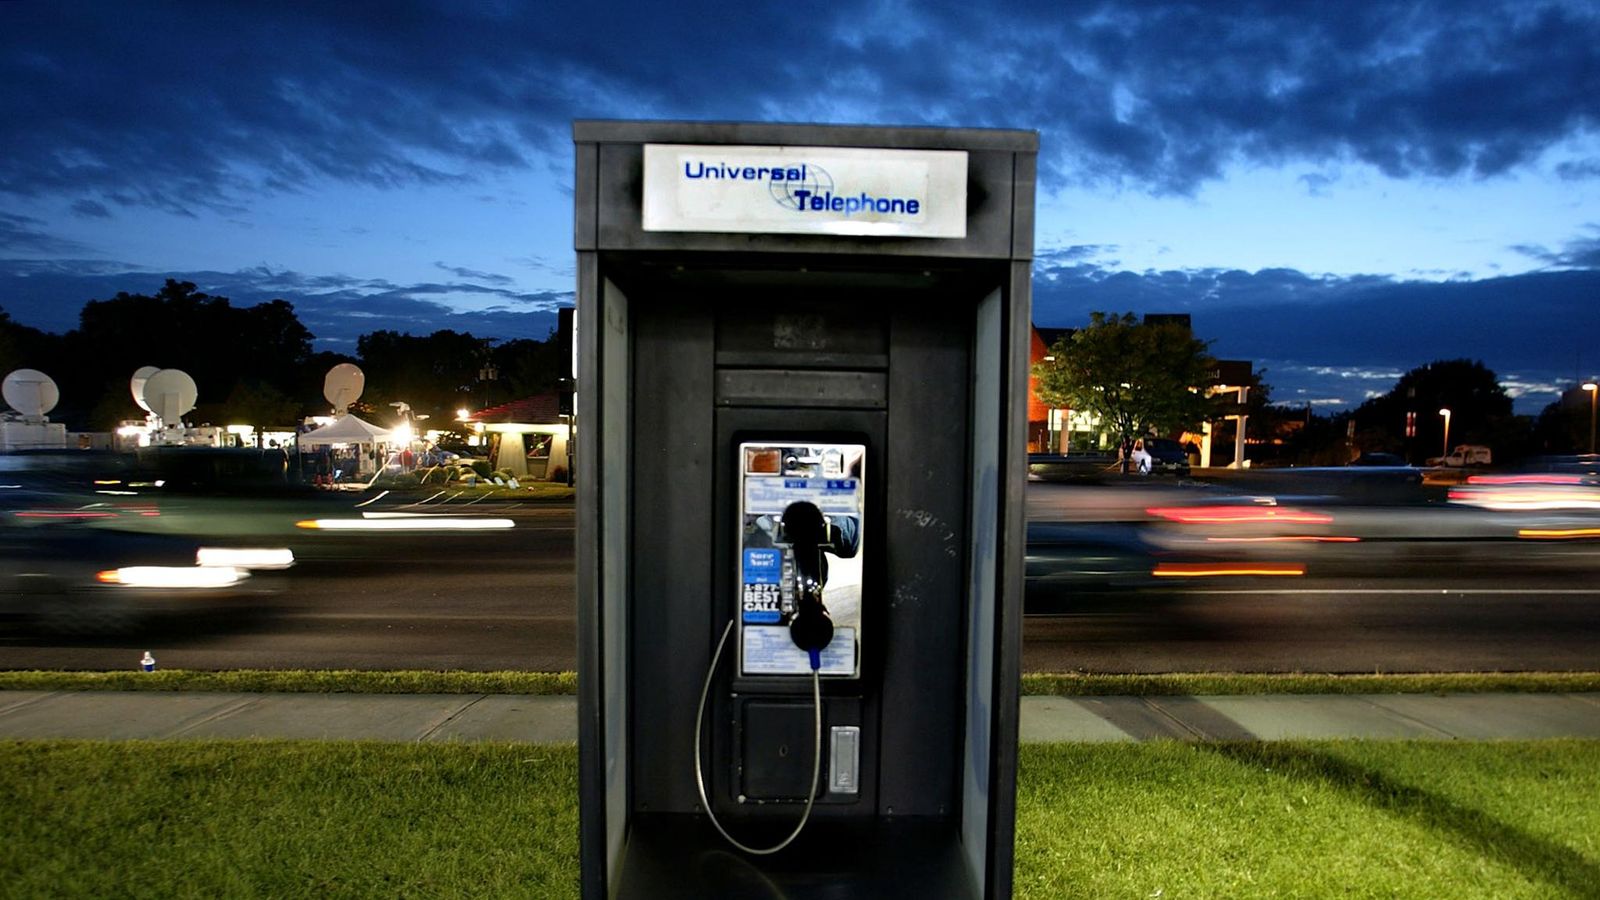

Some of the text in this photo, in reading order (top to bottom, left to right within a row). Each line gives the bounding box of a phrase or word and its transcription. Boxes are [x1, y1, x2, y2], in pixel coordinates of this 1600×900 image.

[685, 162, 806, 181] Universal
[793, 190, 920, 216] Telephone
[744, 591, 779, 603] BEST
[744, 602, 779, 612] CALL
